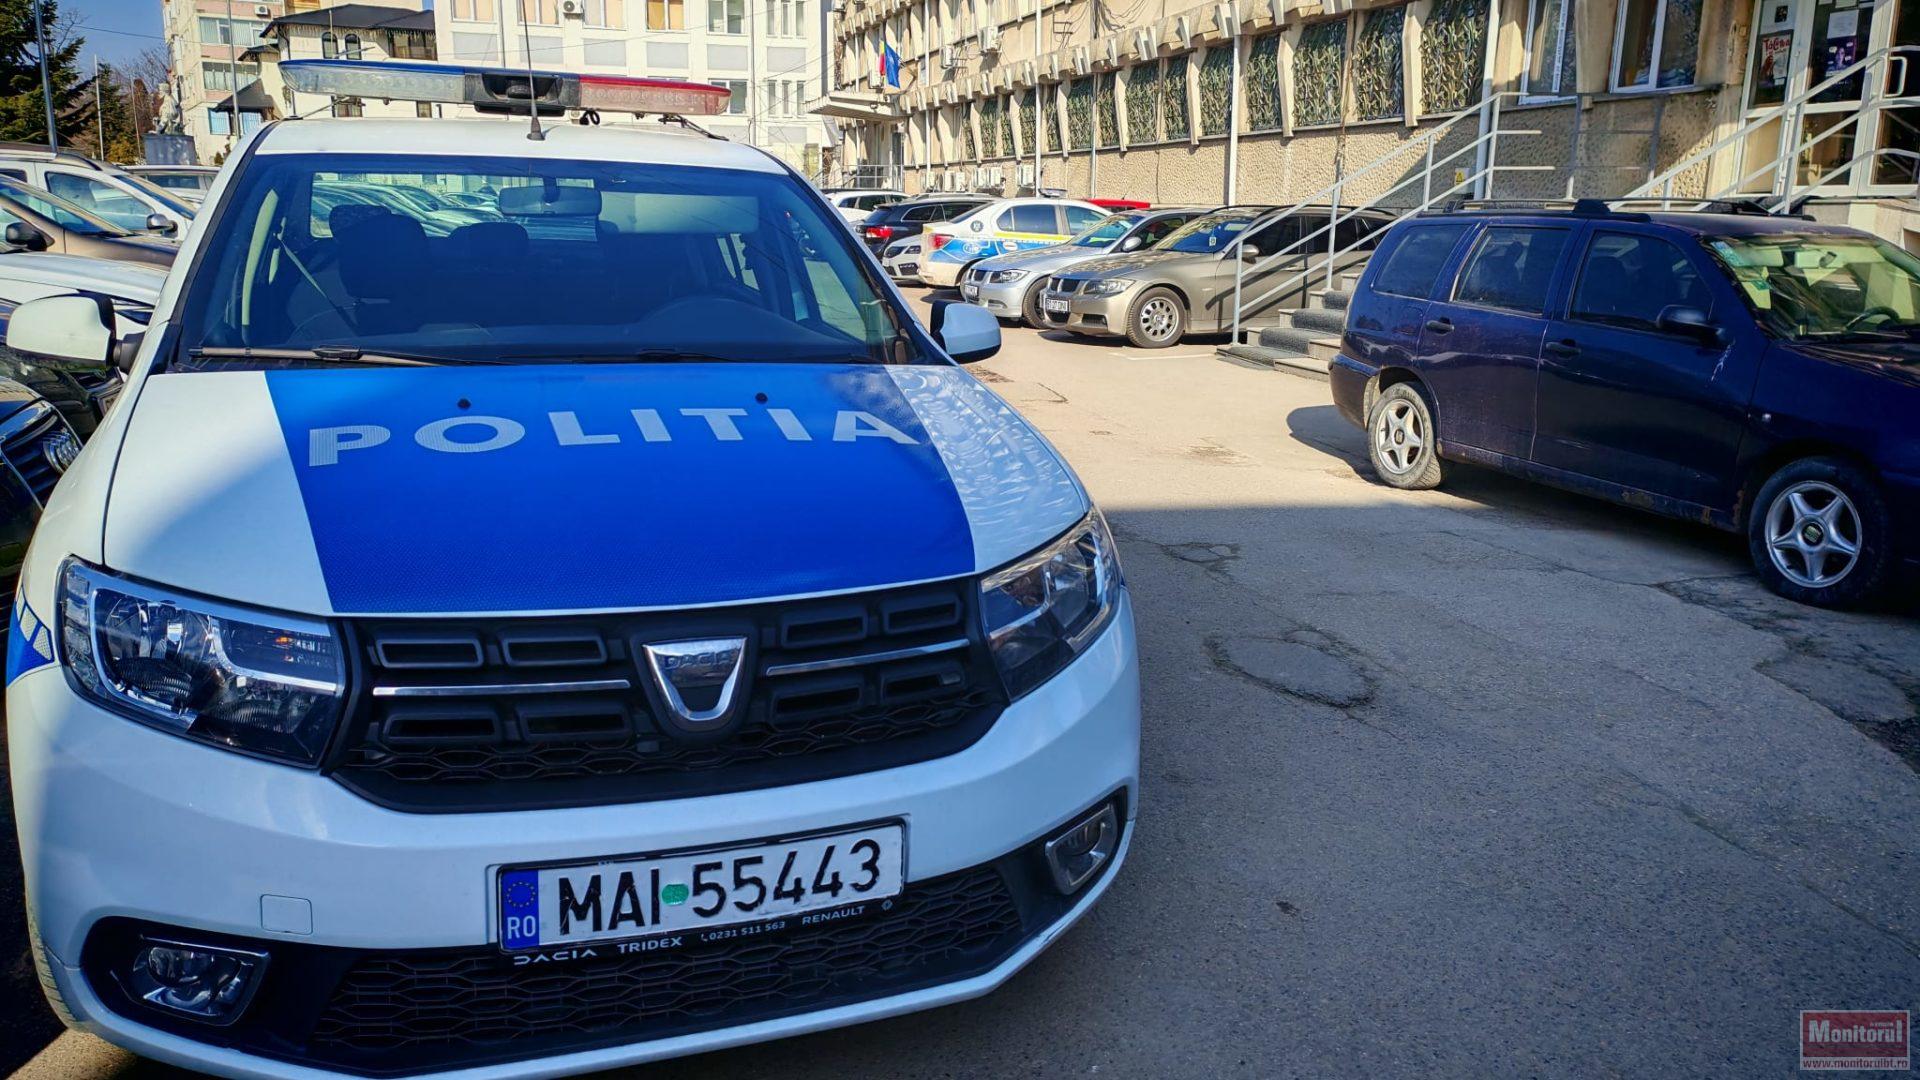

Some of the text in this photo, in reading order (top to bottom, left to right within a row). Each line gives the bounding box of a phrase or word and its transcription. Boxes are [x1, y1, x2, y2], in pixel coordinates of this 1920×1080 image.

[308, 407, 921, 467] POLITIA
[558, 838, 881, 936] MAI 55443
[507, 915, 536, 939] RO
[513, 905, 865, 966] DACIA TRIDEX 0231 511 563 RENAULT
